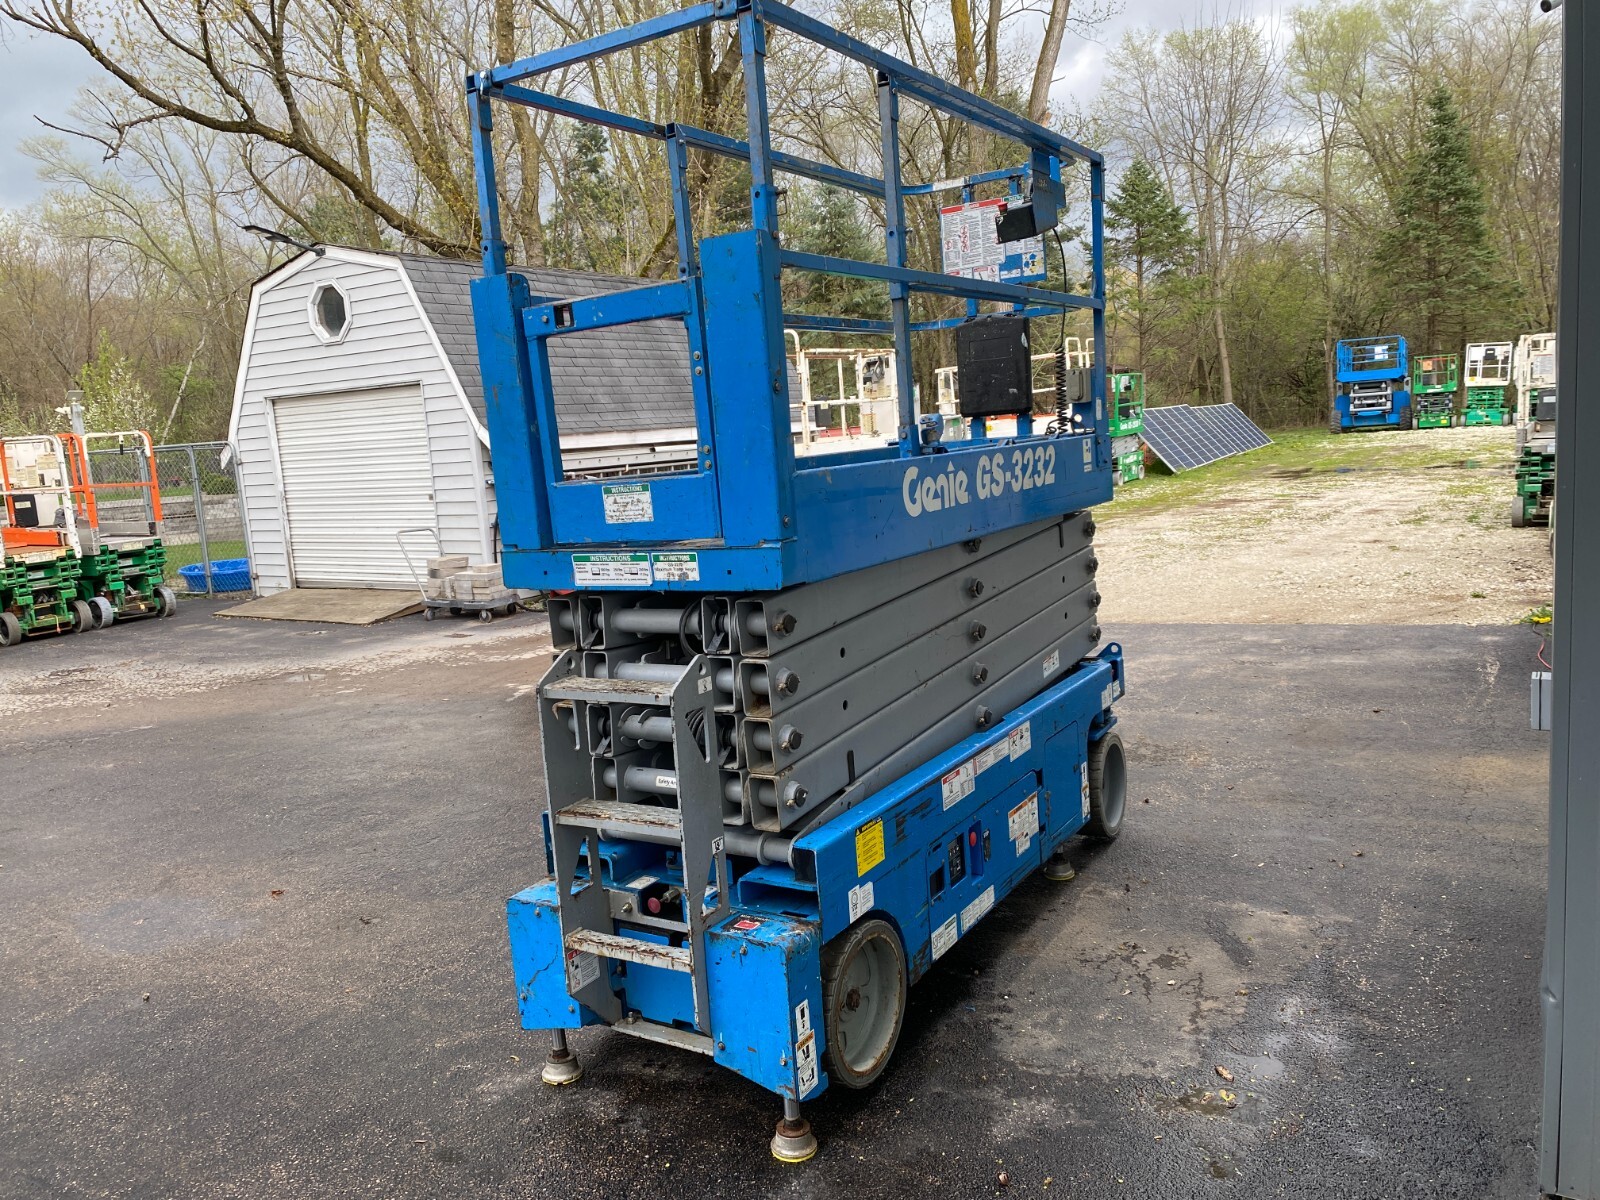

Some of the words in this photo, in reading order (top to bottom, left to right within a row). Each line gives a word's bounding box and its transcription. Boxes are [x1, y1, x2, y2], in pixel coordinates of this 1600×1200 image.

[611, 485, 643, 494] INSTRUCTIONS
[903, 460, 969, 518] Genie
[976, 444, 1056, 500] GS-3232
